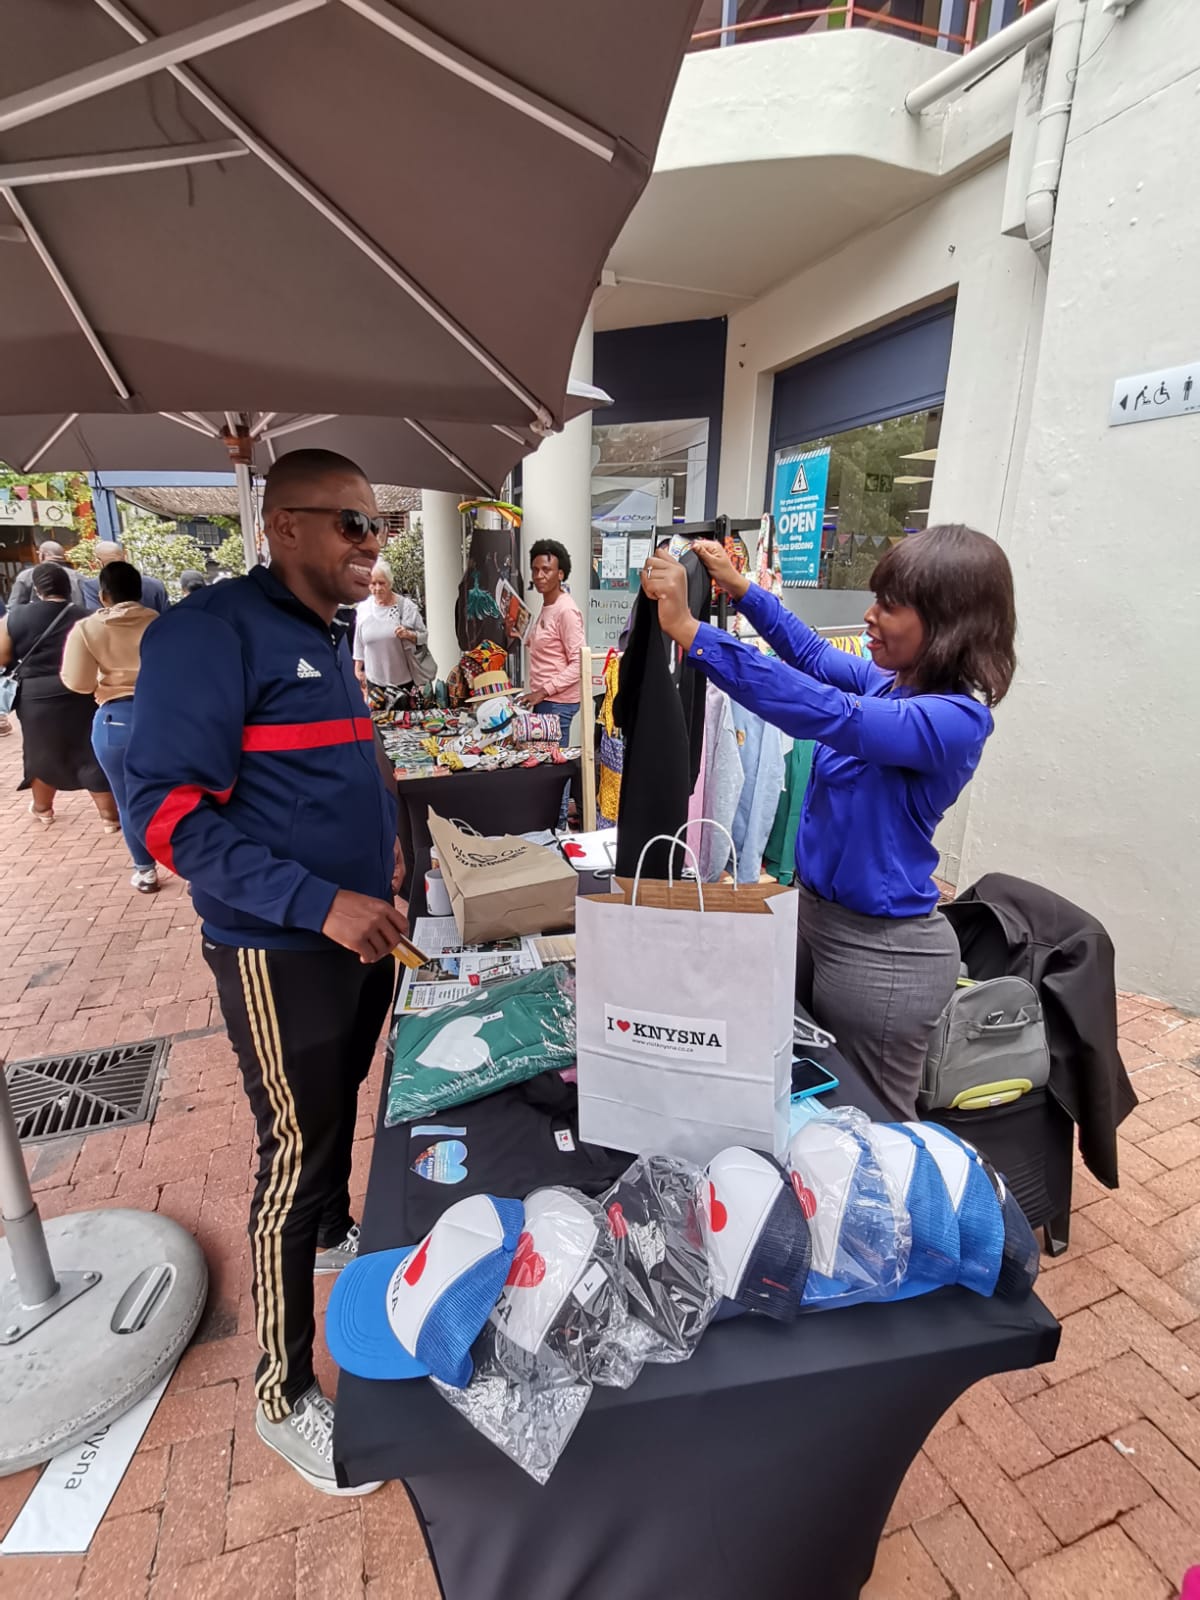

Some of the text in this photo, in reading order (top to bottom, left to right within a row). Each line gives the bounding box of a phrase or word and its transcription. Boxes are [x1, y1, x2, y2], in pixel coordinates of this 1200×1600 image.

[778, 510, 816, 534] OPEN
[606, 1016, 722, 1048] I KNYSNA
[64, 1424, 112, 1490] nysna
